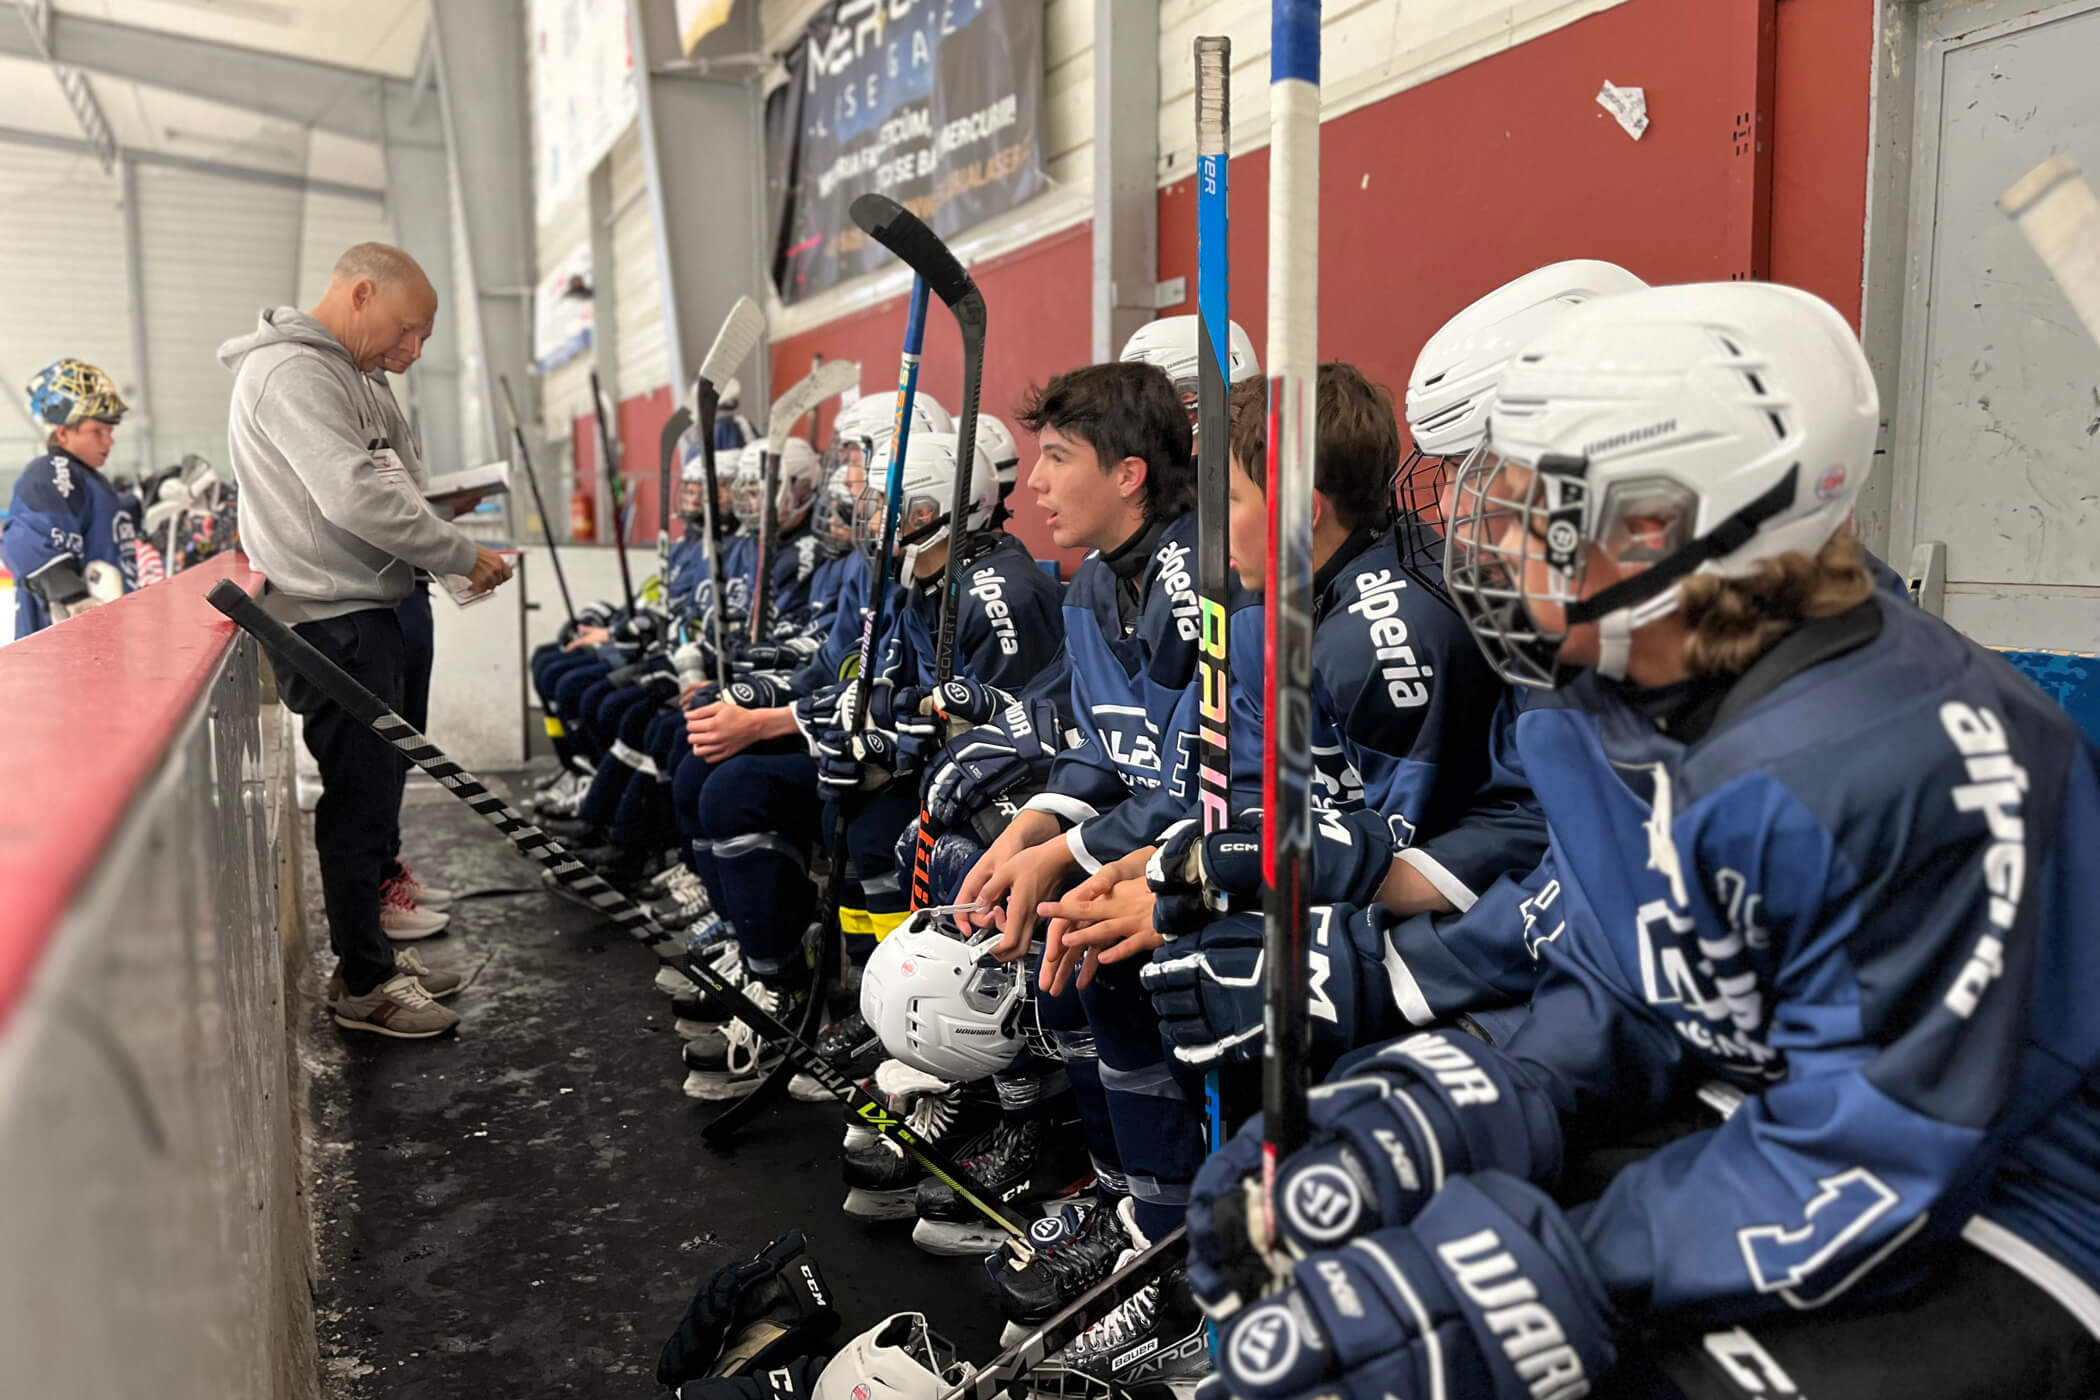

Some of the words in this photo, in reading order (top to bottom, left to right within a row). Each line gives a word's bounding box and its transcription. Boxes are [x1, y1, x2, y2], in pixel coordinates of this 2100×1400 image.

[969, 567, 1018, 655] alperia
[1156, 541, 1199, 641] alperia
[939, 611, 957, 680] COVERT
[1348, 569, 1434, 708] alperia
[1198, 595, 1226, 832] BAUE
[1220, 843, 1258, 852] CCM
[1939, 702, 2029, 1018] alperia
[1309, 906, 1338, 1024] CM
[856, 1101, 899, 1133] LX
[1000, 1180, 1030, 1202] CM
[801, 1264, 827, 1306] CCM
[1114, 1340, 1157, 1368] BAUER
